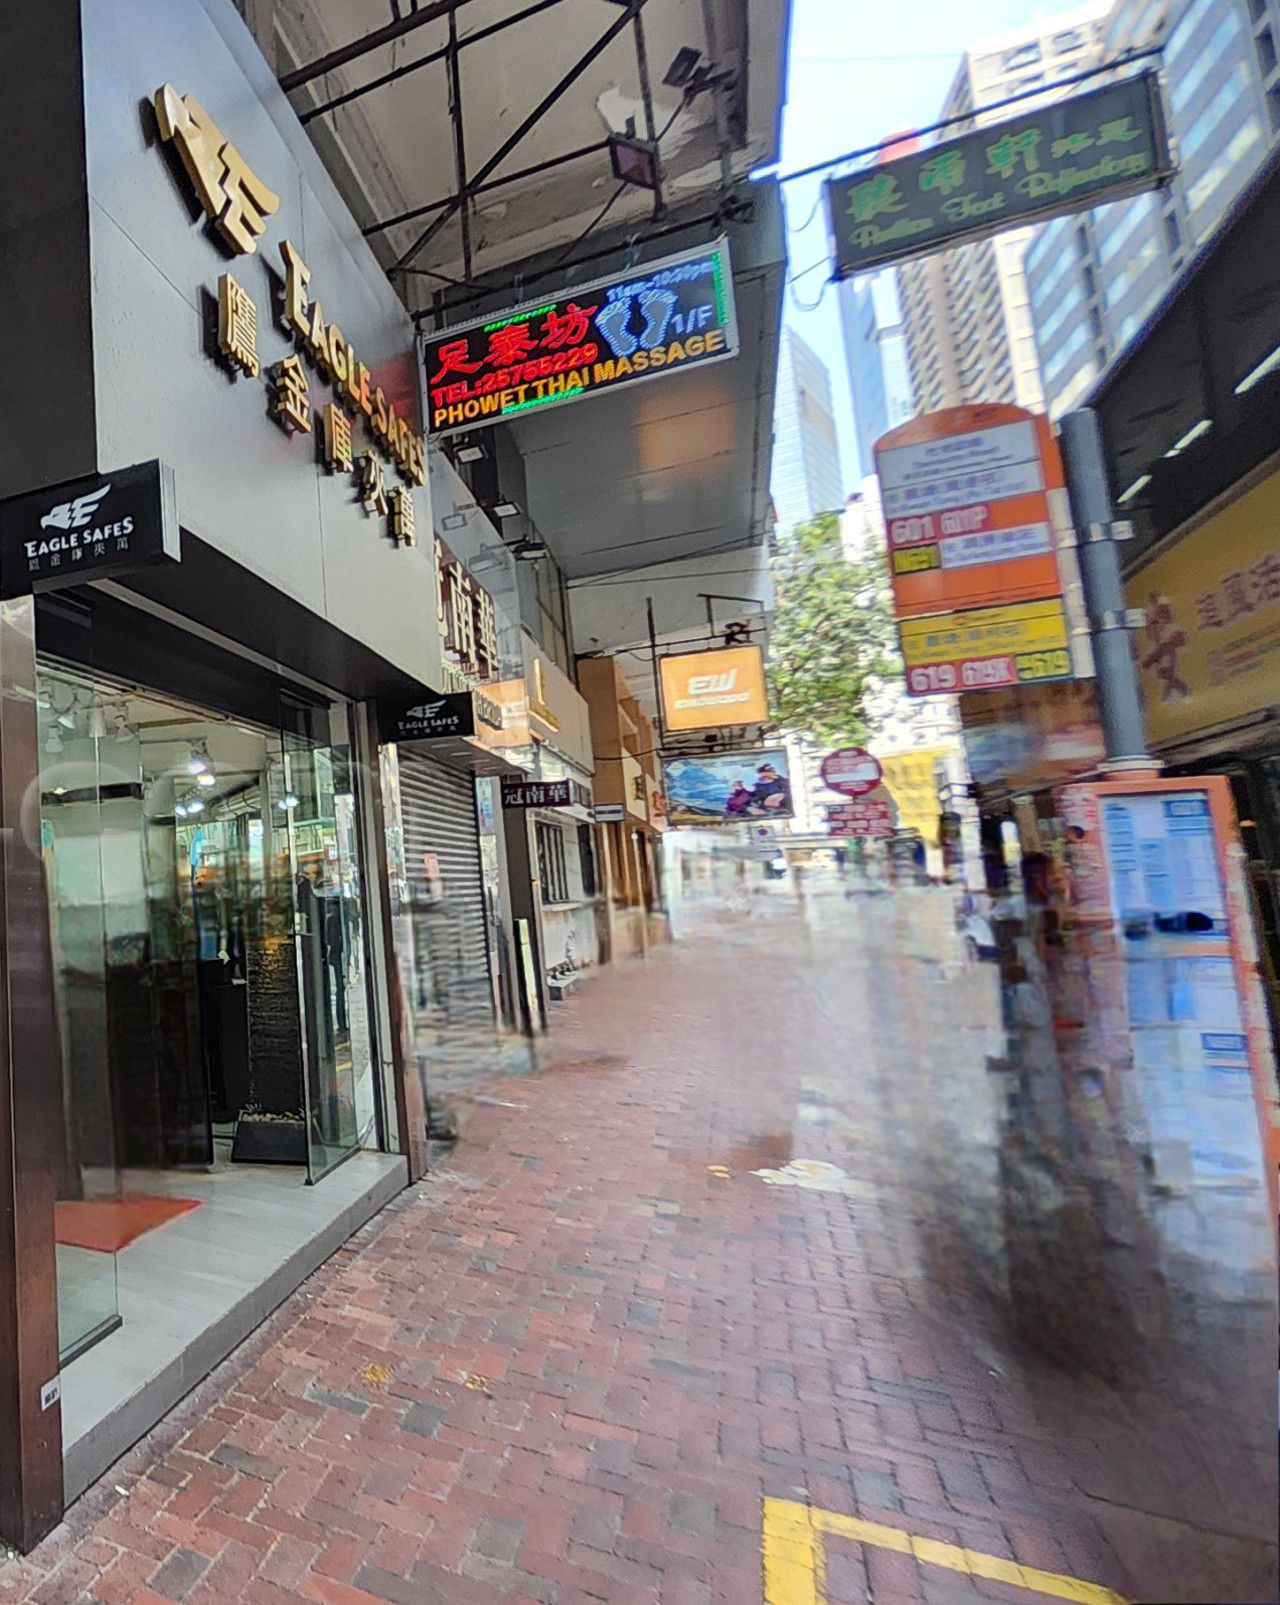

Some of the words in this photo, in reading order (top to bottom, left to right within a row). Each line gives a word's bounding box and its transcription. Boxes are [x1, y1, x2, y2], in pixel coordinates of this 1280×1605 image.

[671, 304, 713, 334] 1/F
[278, 238, 372, 416] EAGLE
[371, 386, 427, 487] SAFES
[435, 384, 533, 427] PHOWET
[531, 366, 591, 399] THAI
[594, 329, 725, 382] MASSAGE
[23, 533, 78, 558] EAGLE
[83, 516, 134, 545] SAFES
[910, 664, 957, 691] 619
[397, 720, 428, 730] EAGLE
[430, 715, 459, 726] SAFES
